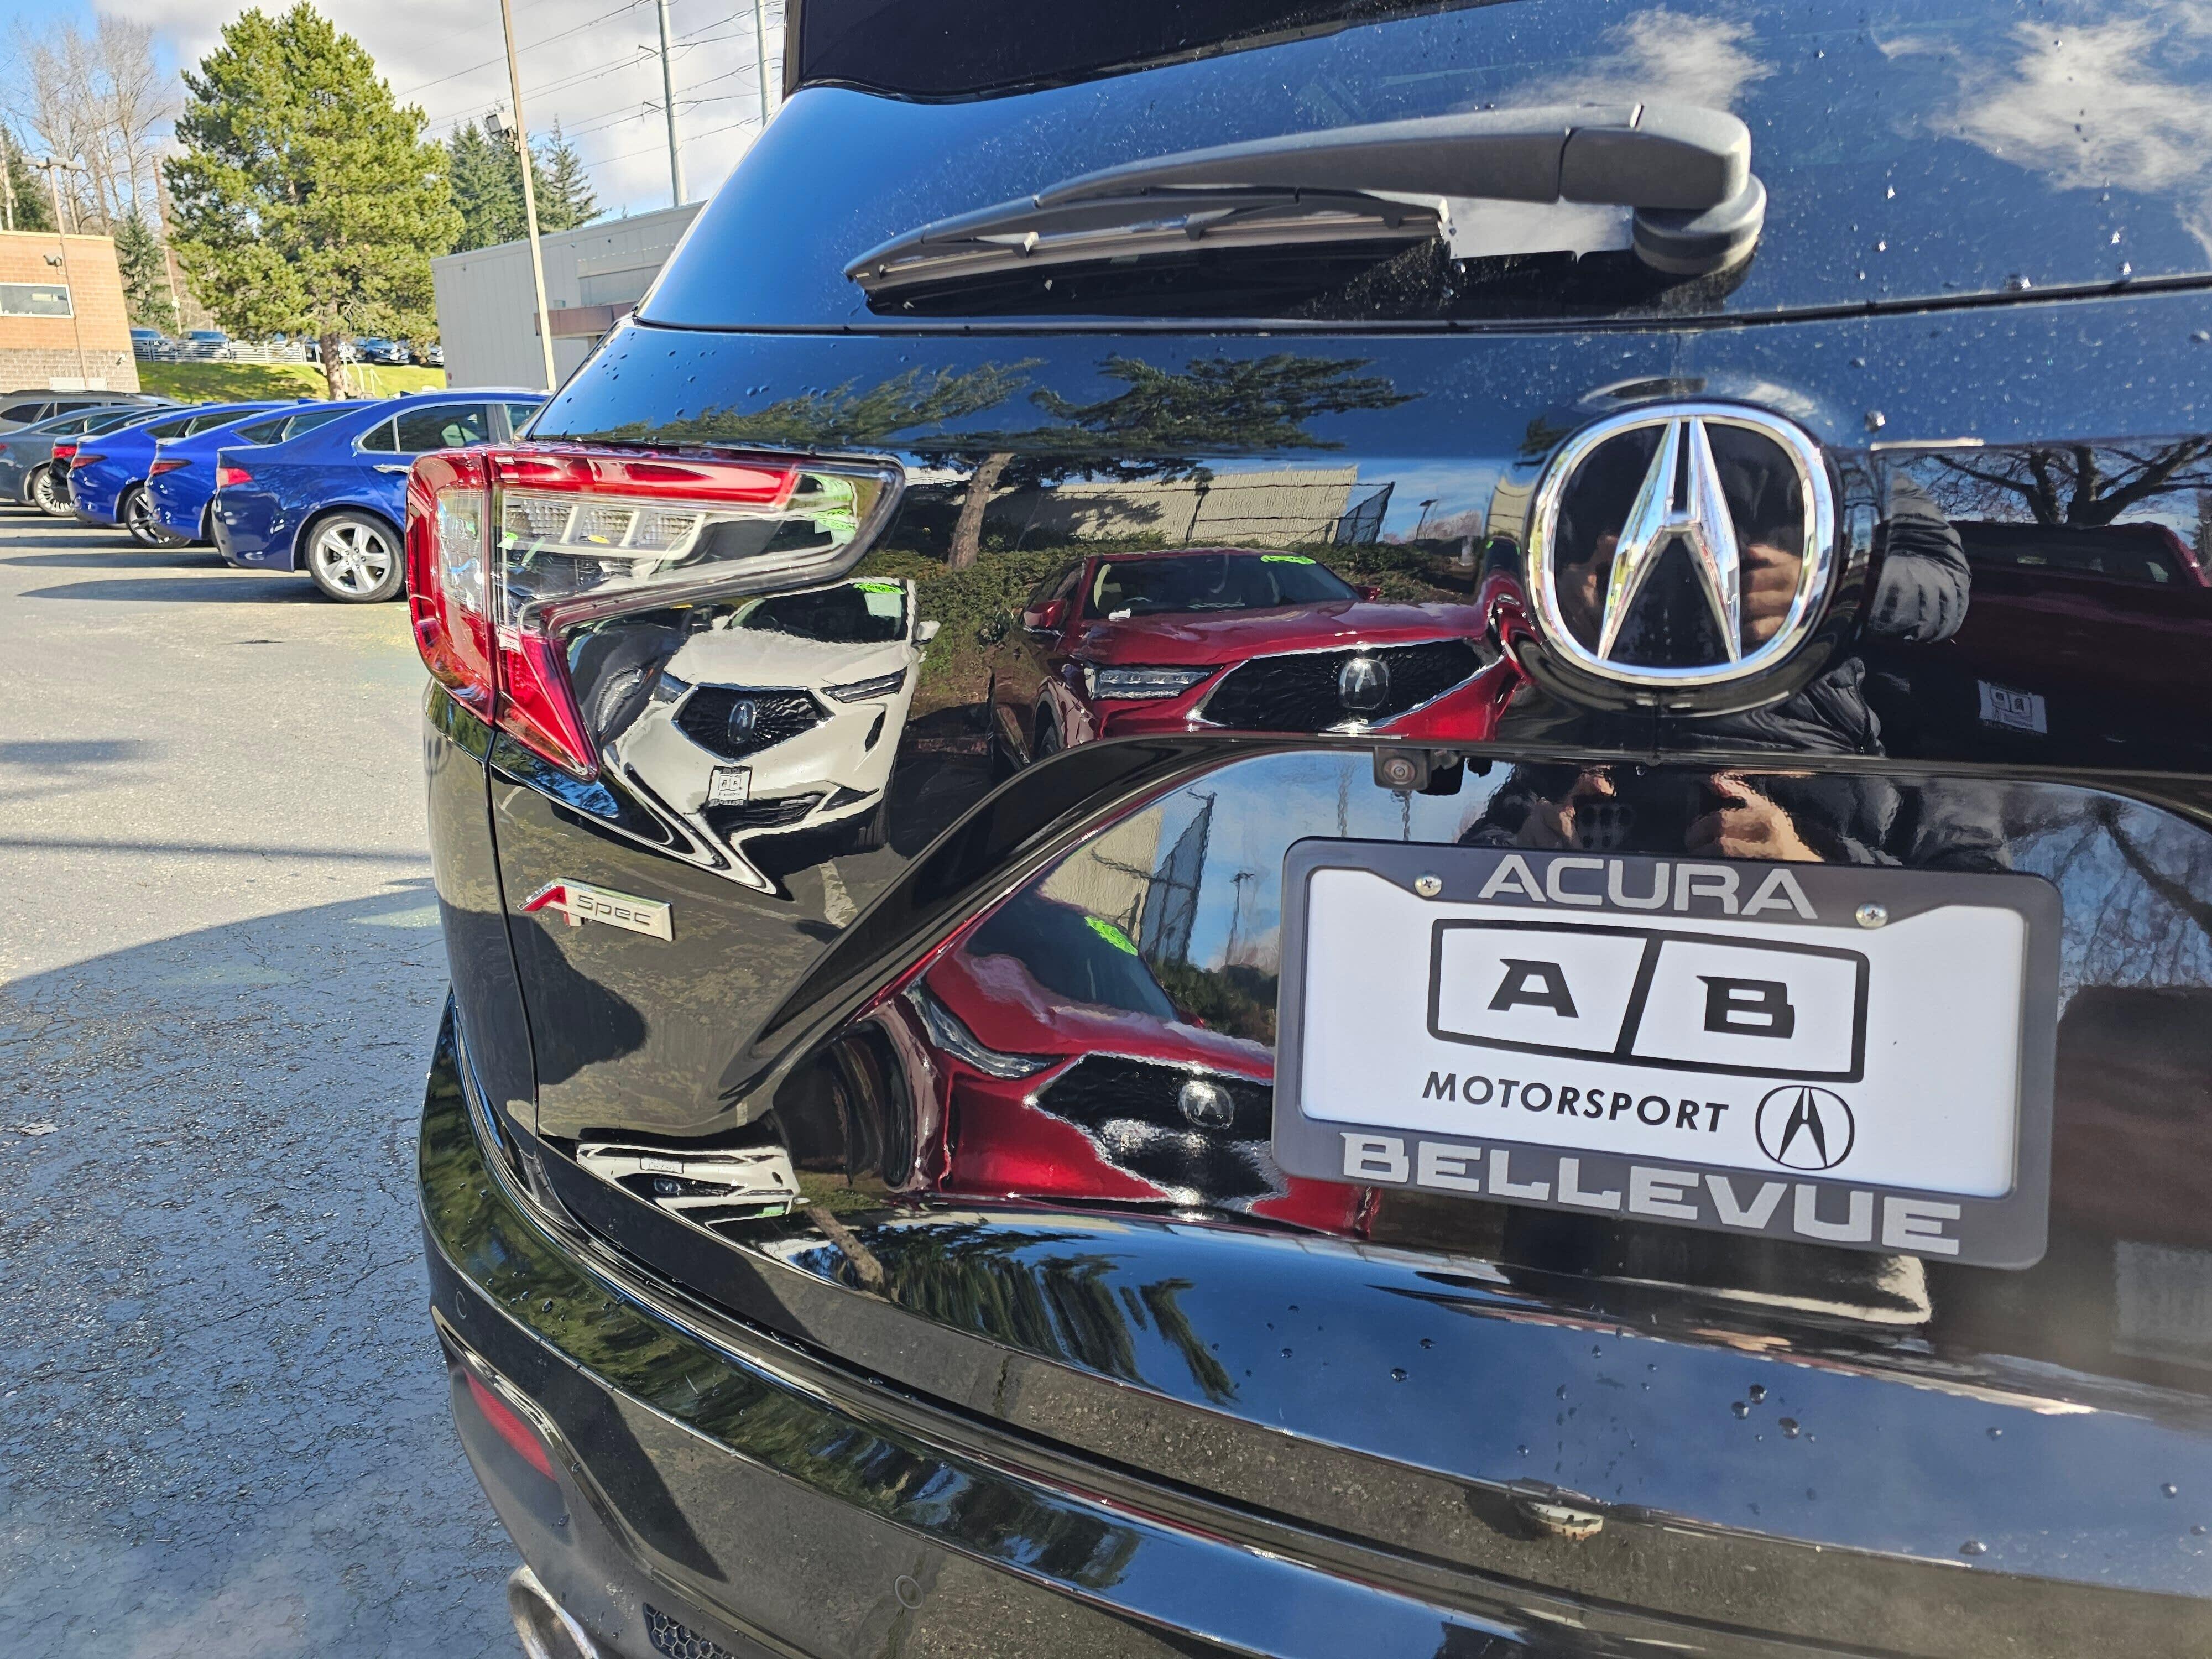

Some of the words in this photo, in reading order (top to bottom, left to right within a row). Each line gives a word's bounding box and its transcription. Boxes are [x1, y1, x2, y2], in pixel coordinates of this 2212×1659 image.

[1478, 854, 1818, 919] ACURA
[1488, 959, 1579, 1018] A
[1697, 975, 1794, 1039] B
[1422, 1071, 1729, 1132] MOTORSPORT
[1340, 1132, 1961, 1255] BELLEVUE
